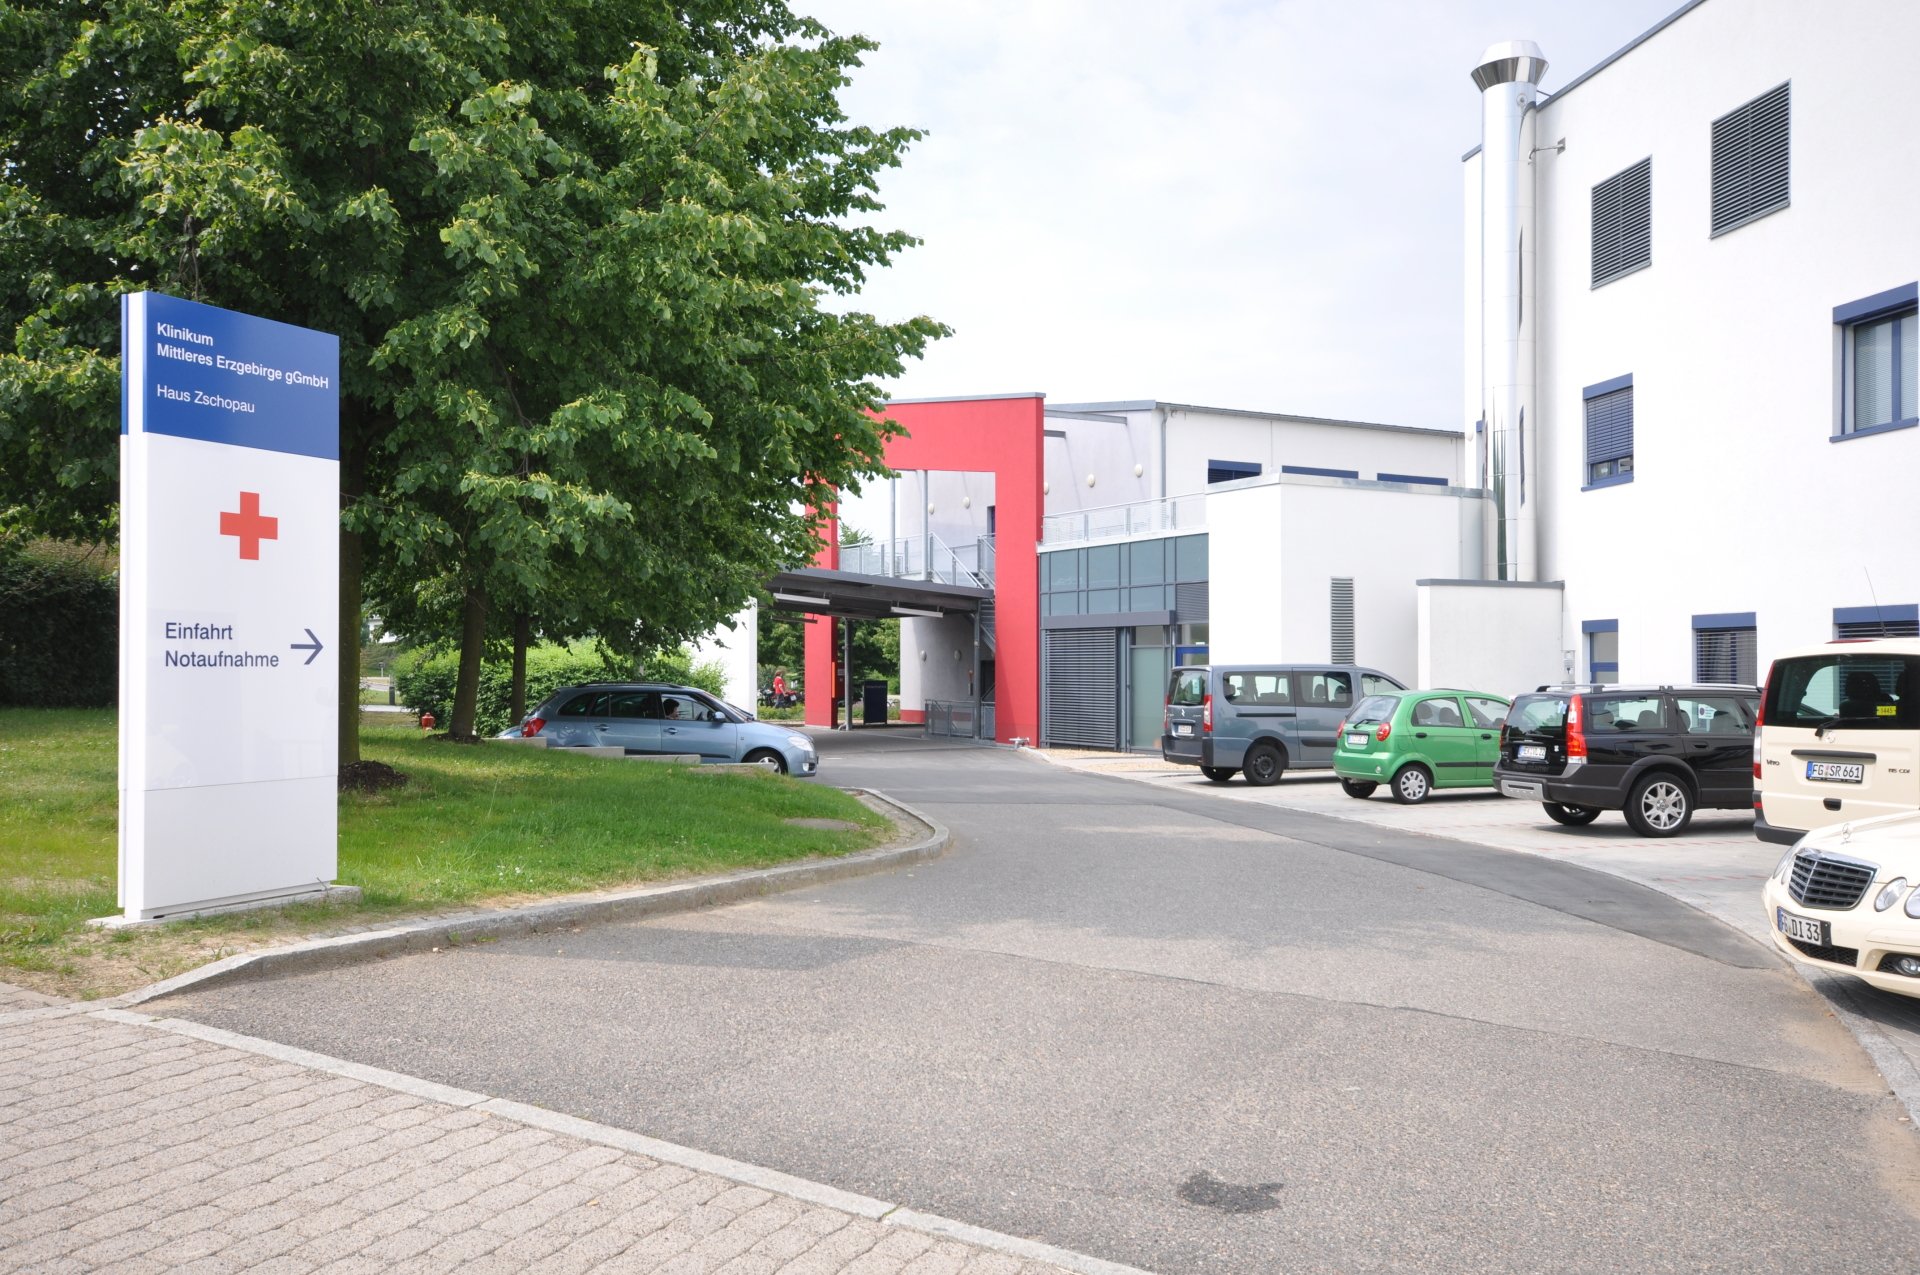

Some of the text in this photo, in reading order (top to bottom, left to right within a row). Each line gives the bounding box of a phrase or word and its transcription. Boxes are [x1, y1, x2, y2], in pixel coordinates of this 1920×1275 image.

[157, 322, 214, 346] Klinikum
[157, 342, 329, 389] Mittleres Erzgebirge gGmbH
[157, 384, 255, 413] Haus Zschopau
[165, 622, 233, 640] Einfahrt
[165, 650, 280, 668] Notaufnahme
[1812, 763, 1861, 779] FG SR 661
[1806, 922, 1820, 941] 33
